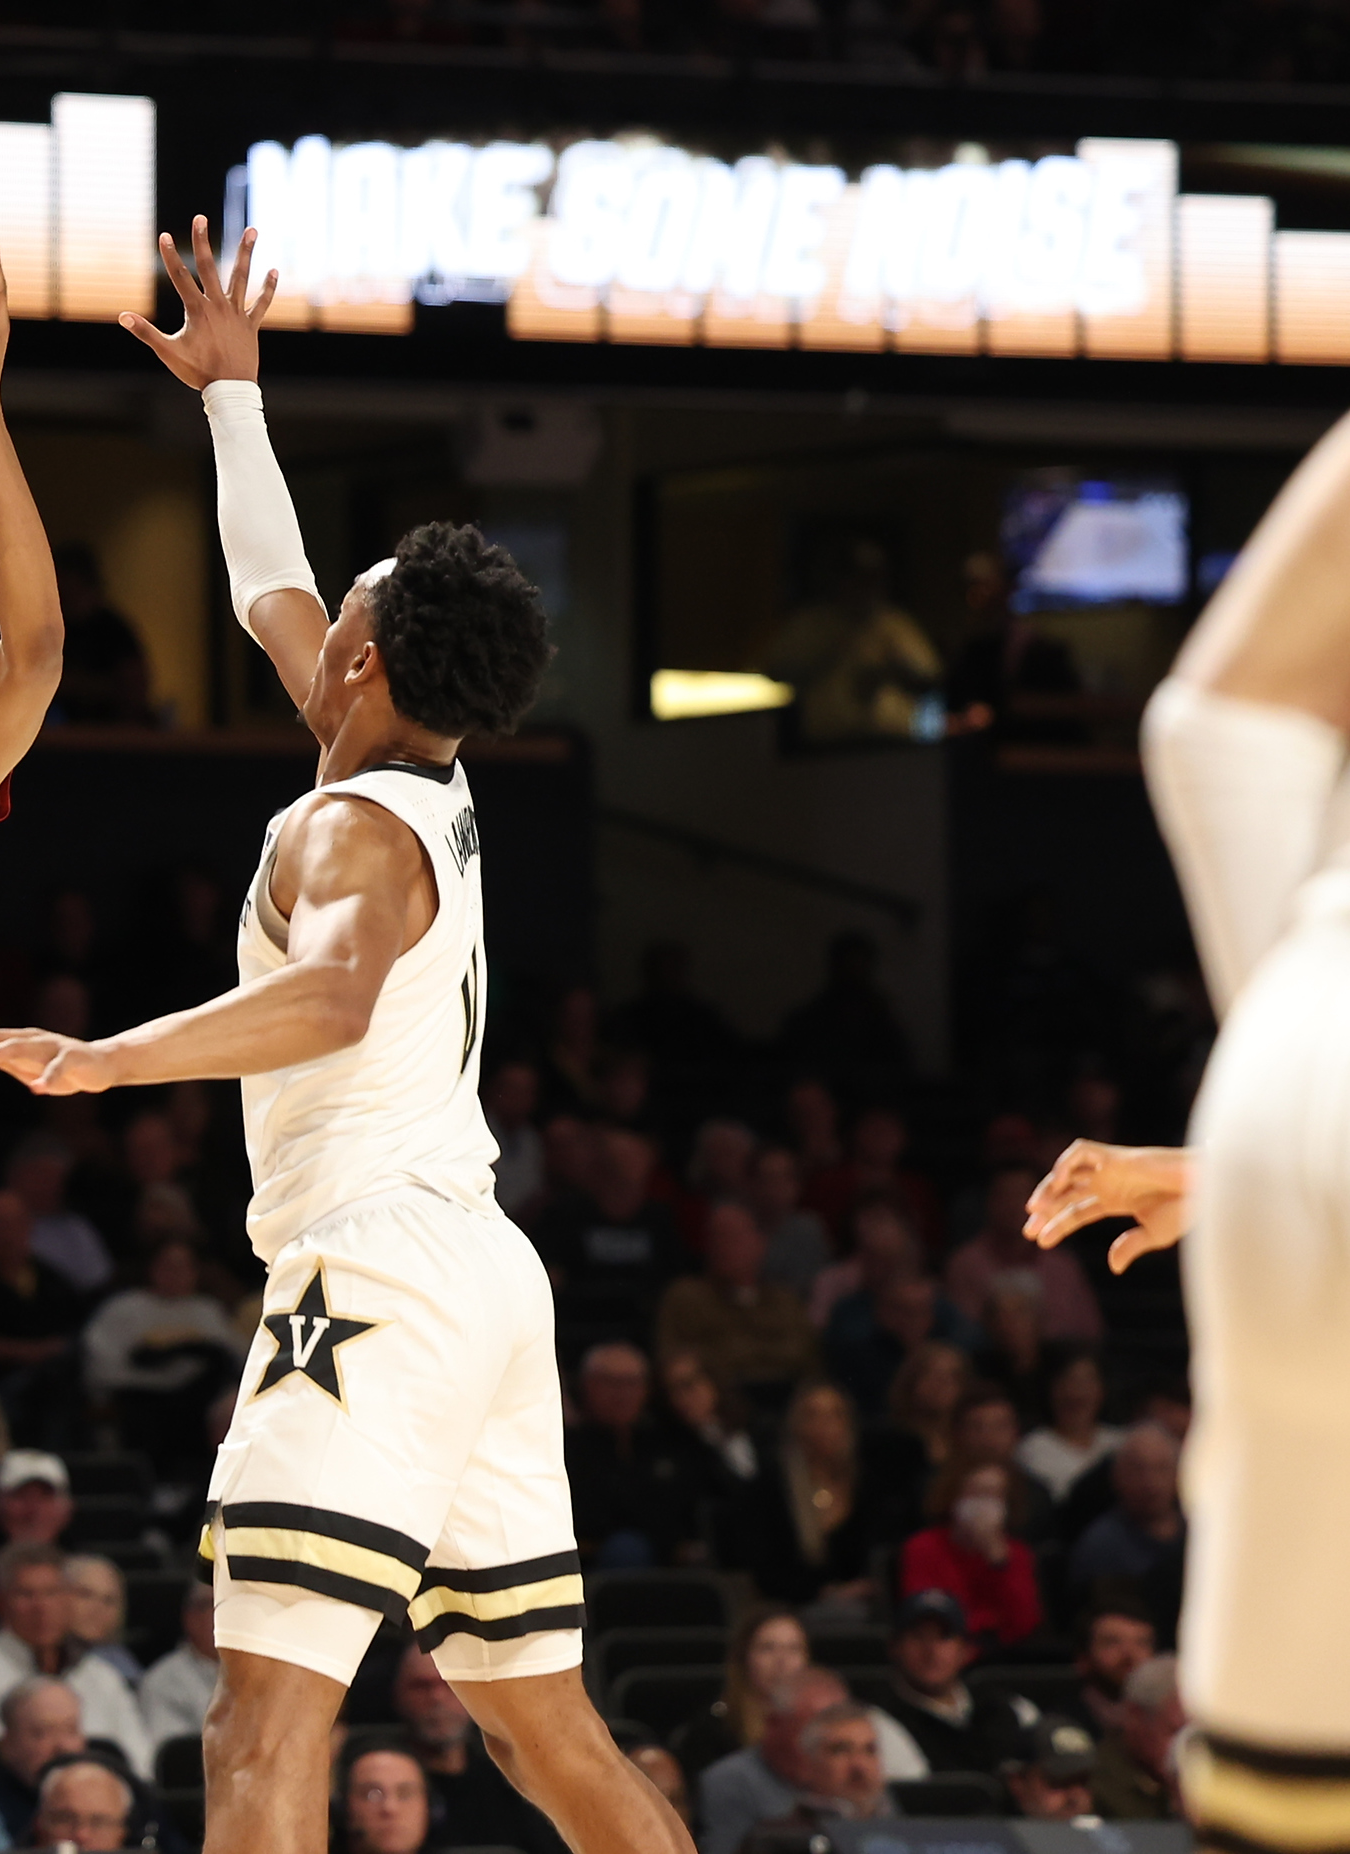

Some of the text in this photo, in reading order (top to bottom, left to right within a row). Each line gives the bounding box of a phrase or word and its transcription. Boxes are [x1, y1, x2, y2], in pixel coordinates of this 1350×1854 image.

[247, 135, 550, 281] MAKE
[551, 142, 844, 298] SOME
[289, 1315, 329, 1367] V
